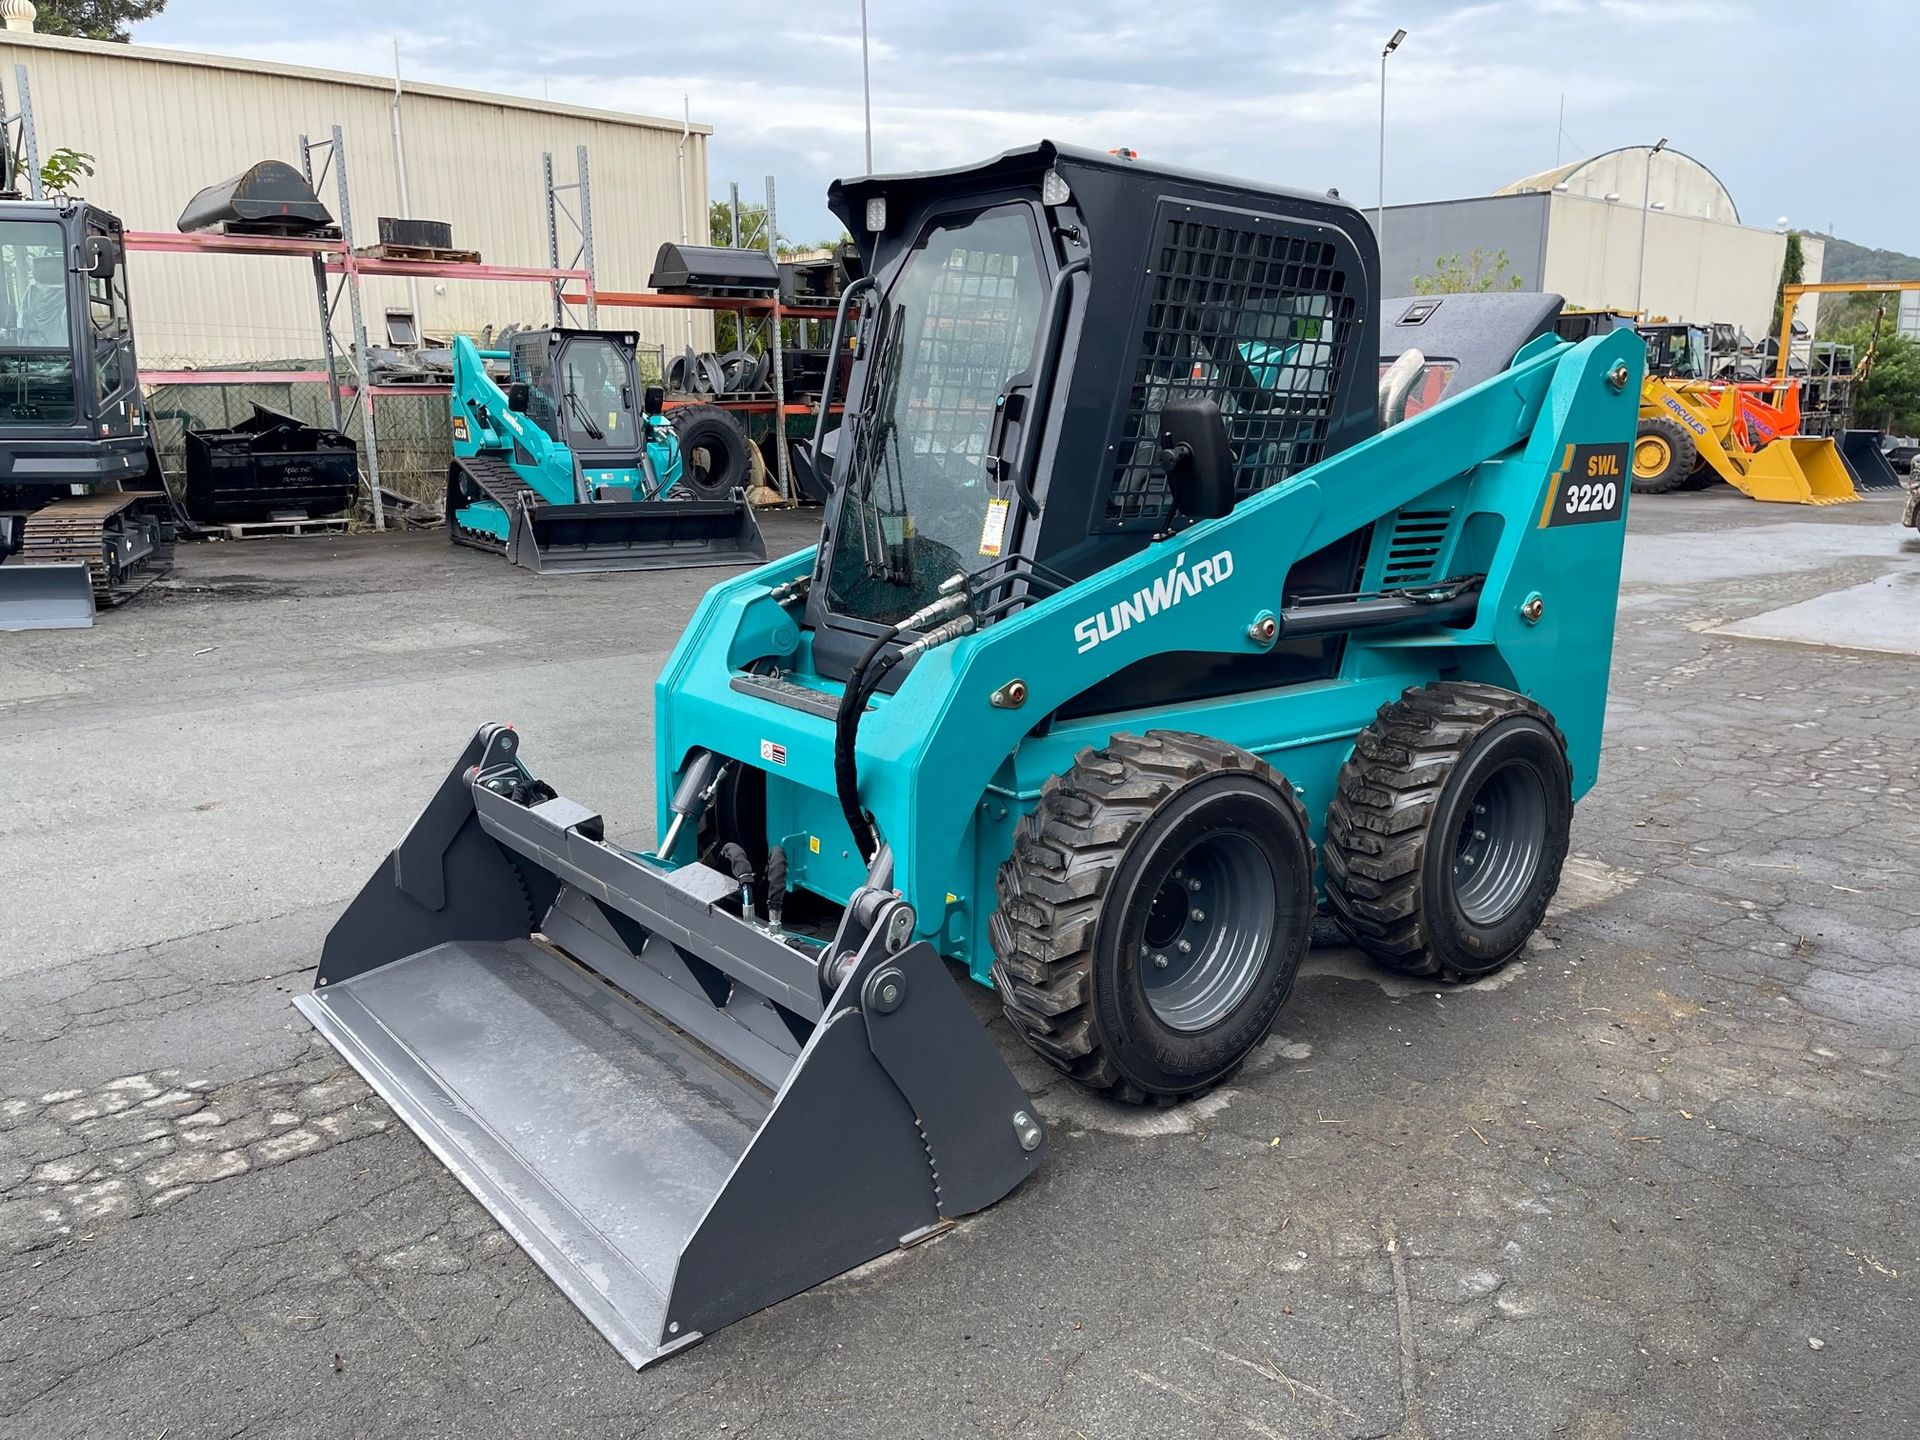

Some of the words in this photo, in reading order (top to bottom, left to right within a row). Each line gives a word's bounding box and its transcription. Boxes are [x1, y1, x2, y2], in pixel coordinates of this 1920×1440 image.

[1660, 393, 1707, 435] HERCULES
[1743, 409, 1773, 436] RCULES
[1587, 454, 1619, 477] SWL
[1565, 482, 1616, 514] 3220
[1074, 550, 1234, 654] SUNWARD
